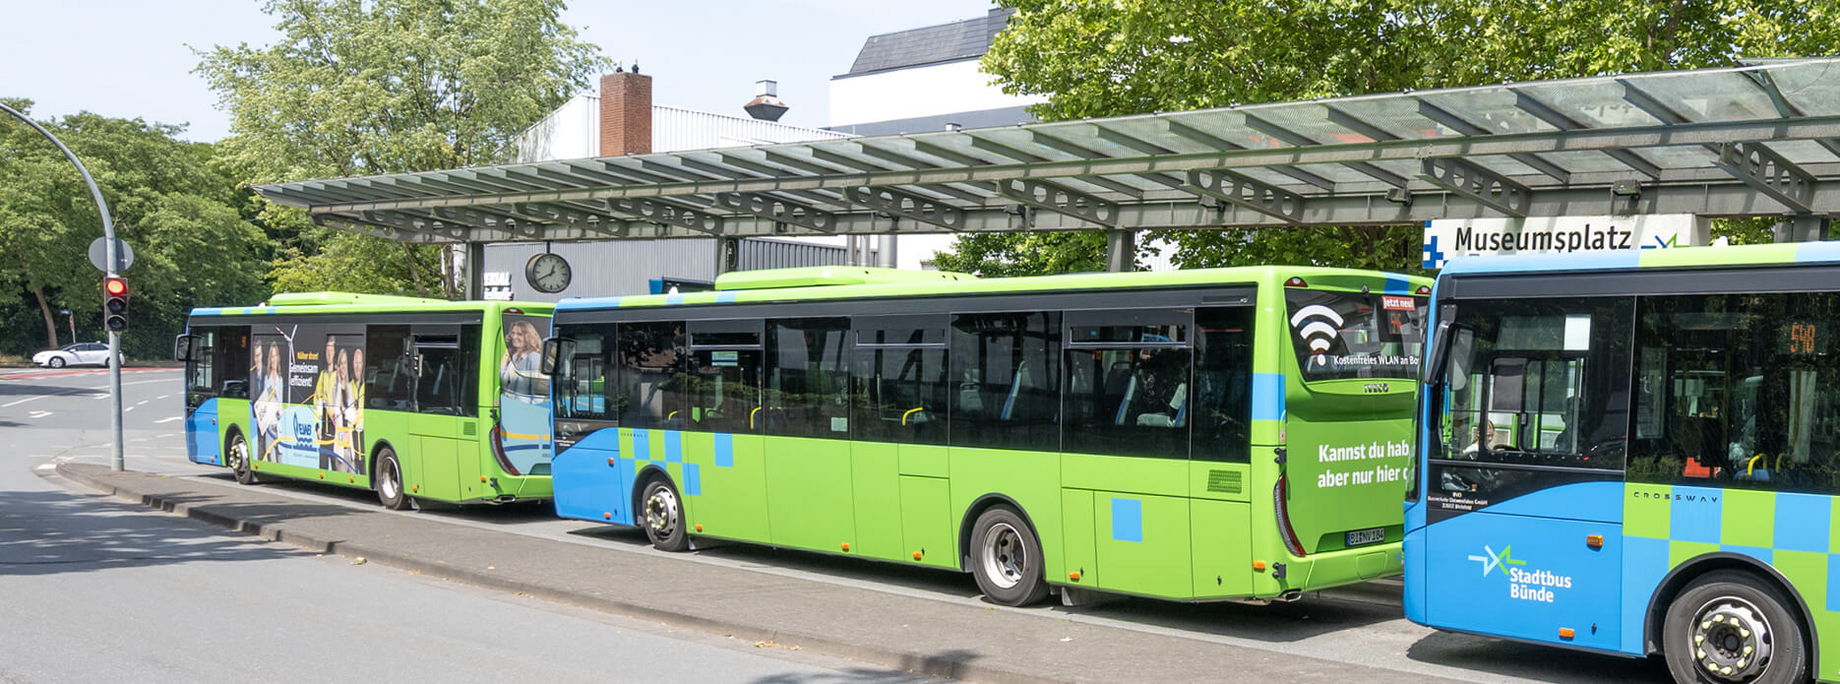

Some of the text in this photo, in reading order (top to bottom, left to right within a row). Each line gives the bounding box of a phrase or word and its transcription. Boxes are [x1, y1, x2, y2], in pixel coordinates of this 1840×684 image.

[1455, 224, 1631, 252] Museumsplatz
[1334, 356, 1376, 365] Kostenfreies
[1377, 356, 1399, 365] WLAN
[1318, 444, 1366, 462] Kannst
[1368, 442, 1385, 459] du
[1318, 470, 1349, 488] aber
[1352, 470, 1374, 485] nur
[1376, 465, 1401, 482] hier
[1510, 567, 1572, 589] Stadtbus
[1510, 583, 1554, 603] Bünde
